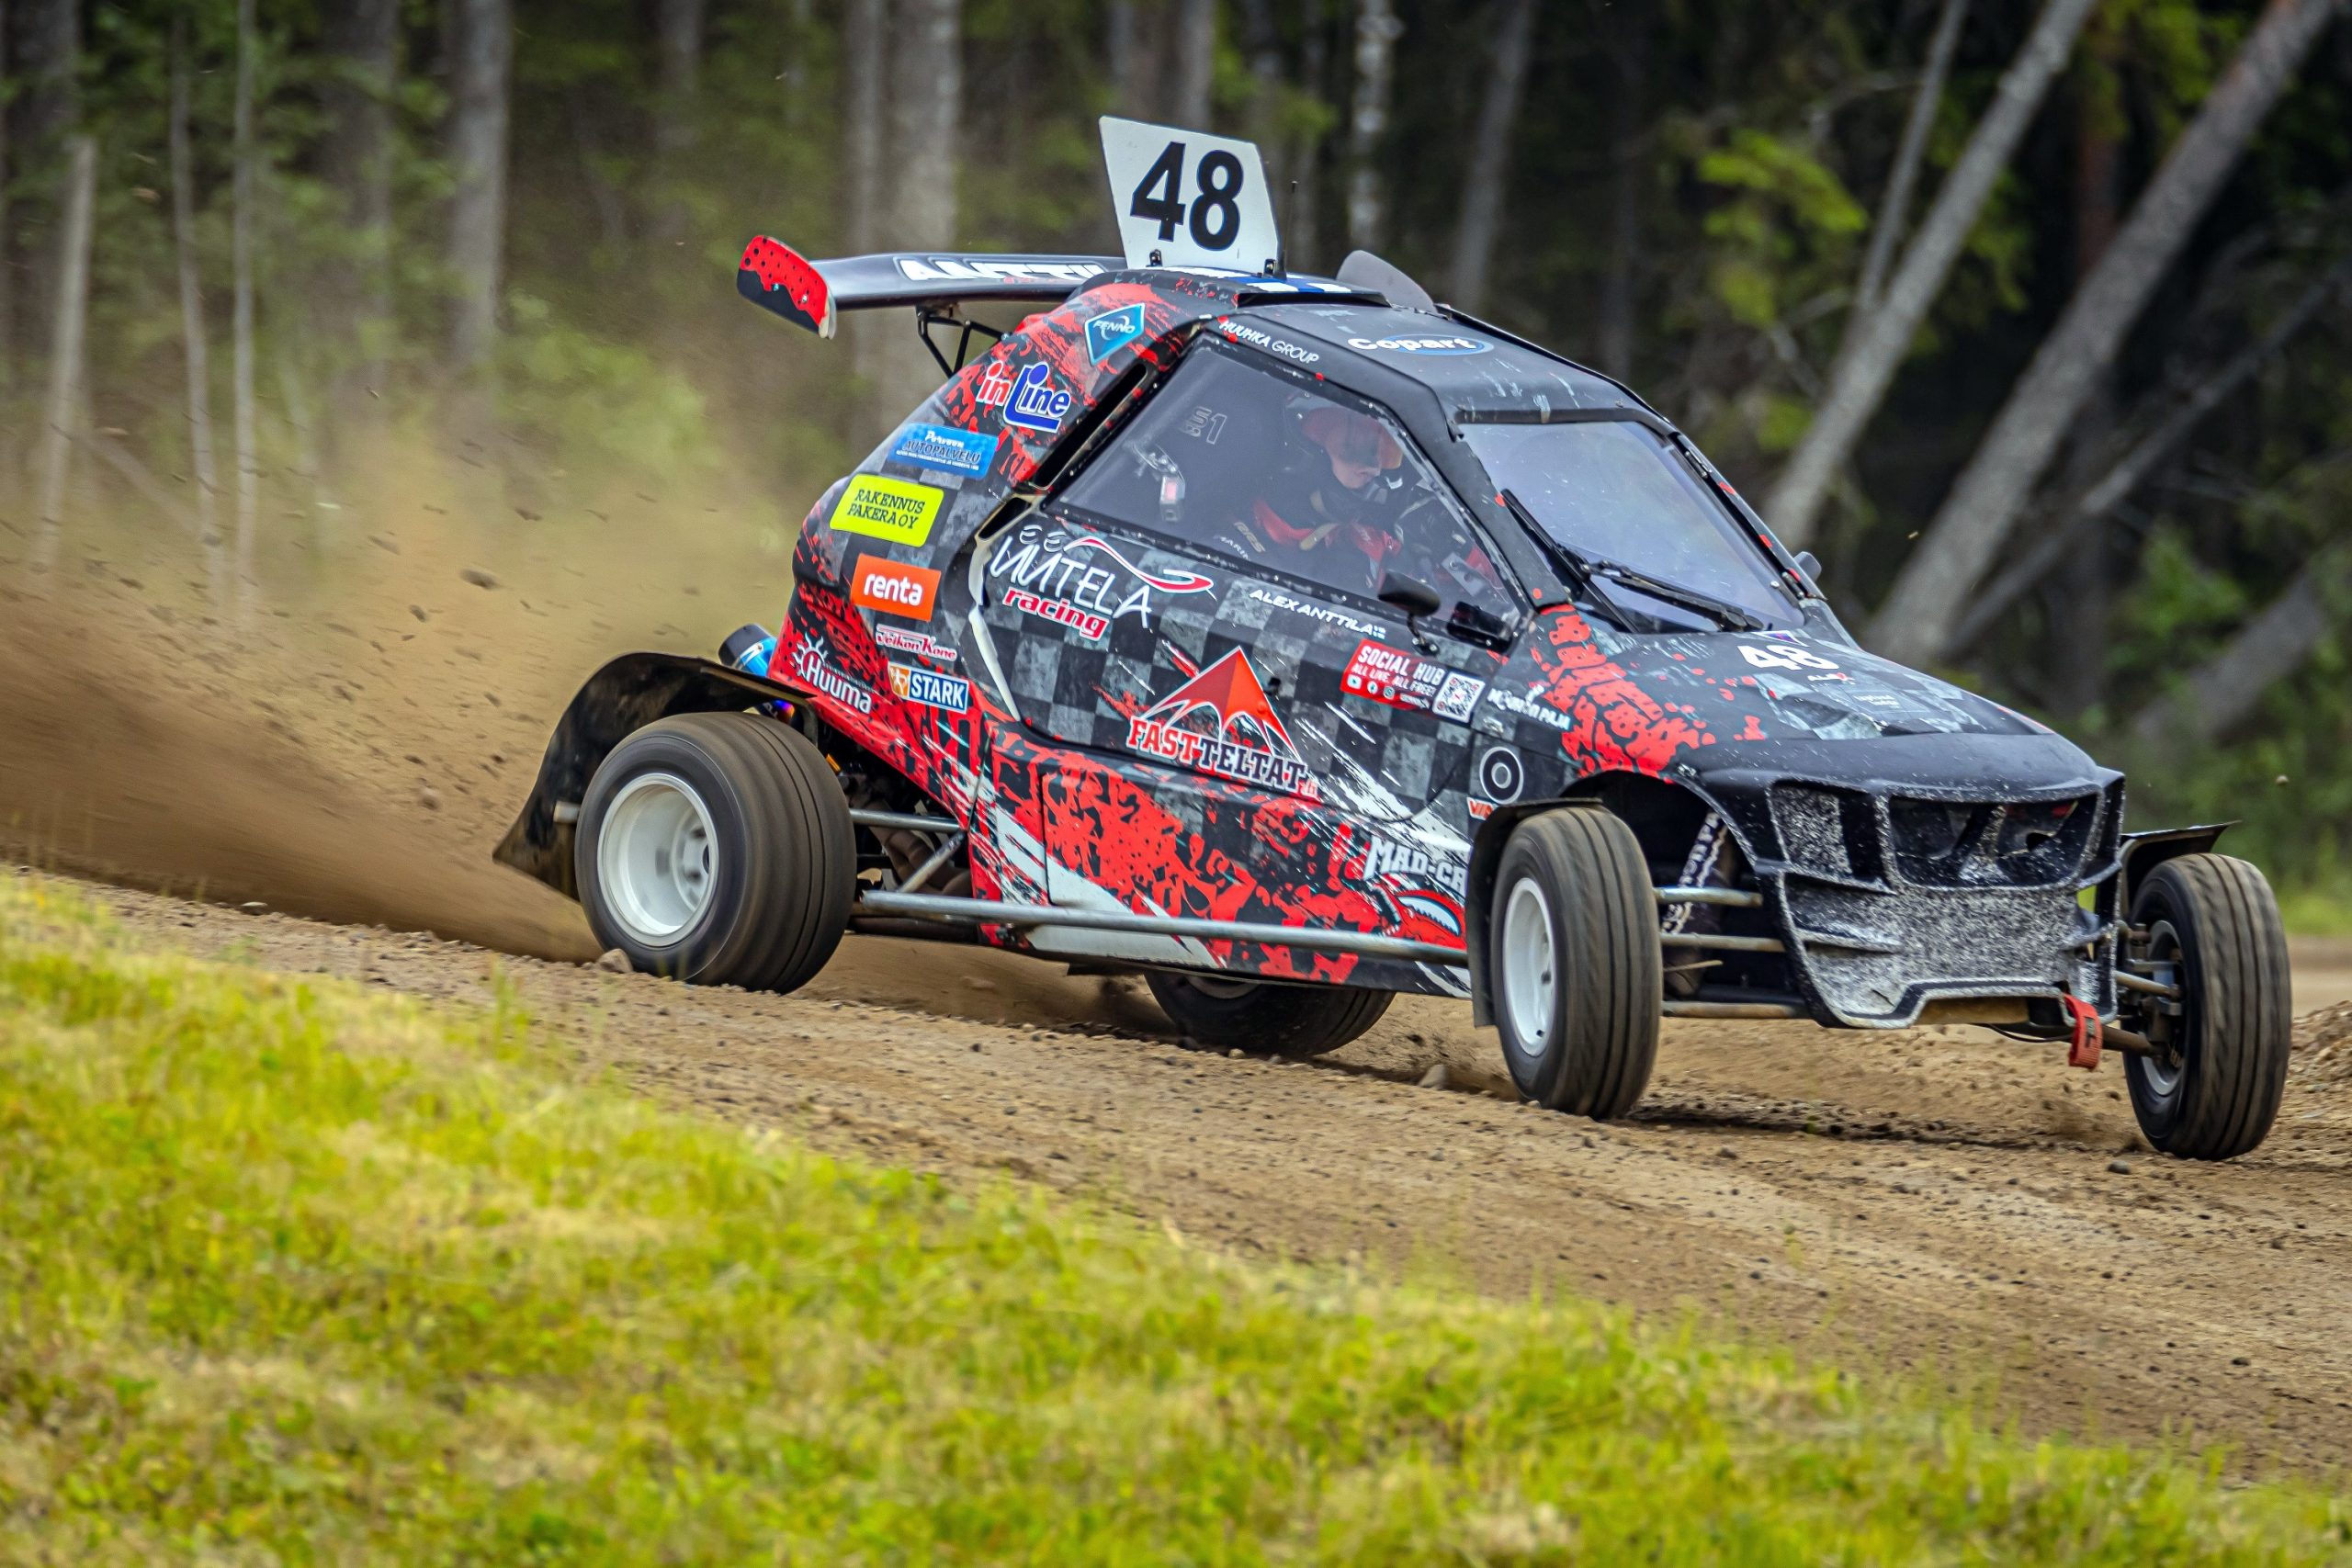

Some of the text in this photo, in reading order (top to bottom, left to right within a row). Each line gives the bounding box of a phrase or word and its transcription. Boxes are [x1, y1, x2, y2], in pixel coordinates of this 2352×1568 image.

[1130, 141, 1244, 252] 48
[1092, 320, 1136, 334] FENNO
[1218, 320, 1319, 364] HUUHKA GROUP
[1347, 336, 1477, 352] Copart
[902, 441, 982, 465] AUTOPALVELU
[847, 502, 919, 530] PAKERA OY
[854, 489, 925, 514] RAKENNUS
[864, 573, 923, 606] renta
[1002, 586, 1110, 641] racing
[1250, 589, 1374, 637] ALEX ANTTILA
[920, 637, 957, 661] Kone
[1357, 645, 1446, 686] SOCIAL HUB
[1736, 645, 1840, 671] 48
[806, 655, 872, 715] Huuma
[910, 672, 965, 708] STARK
